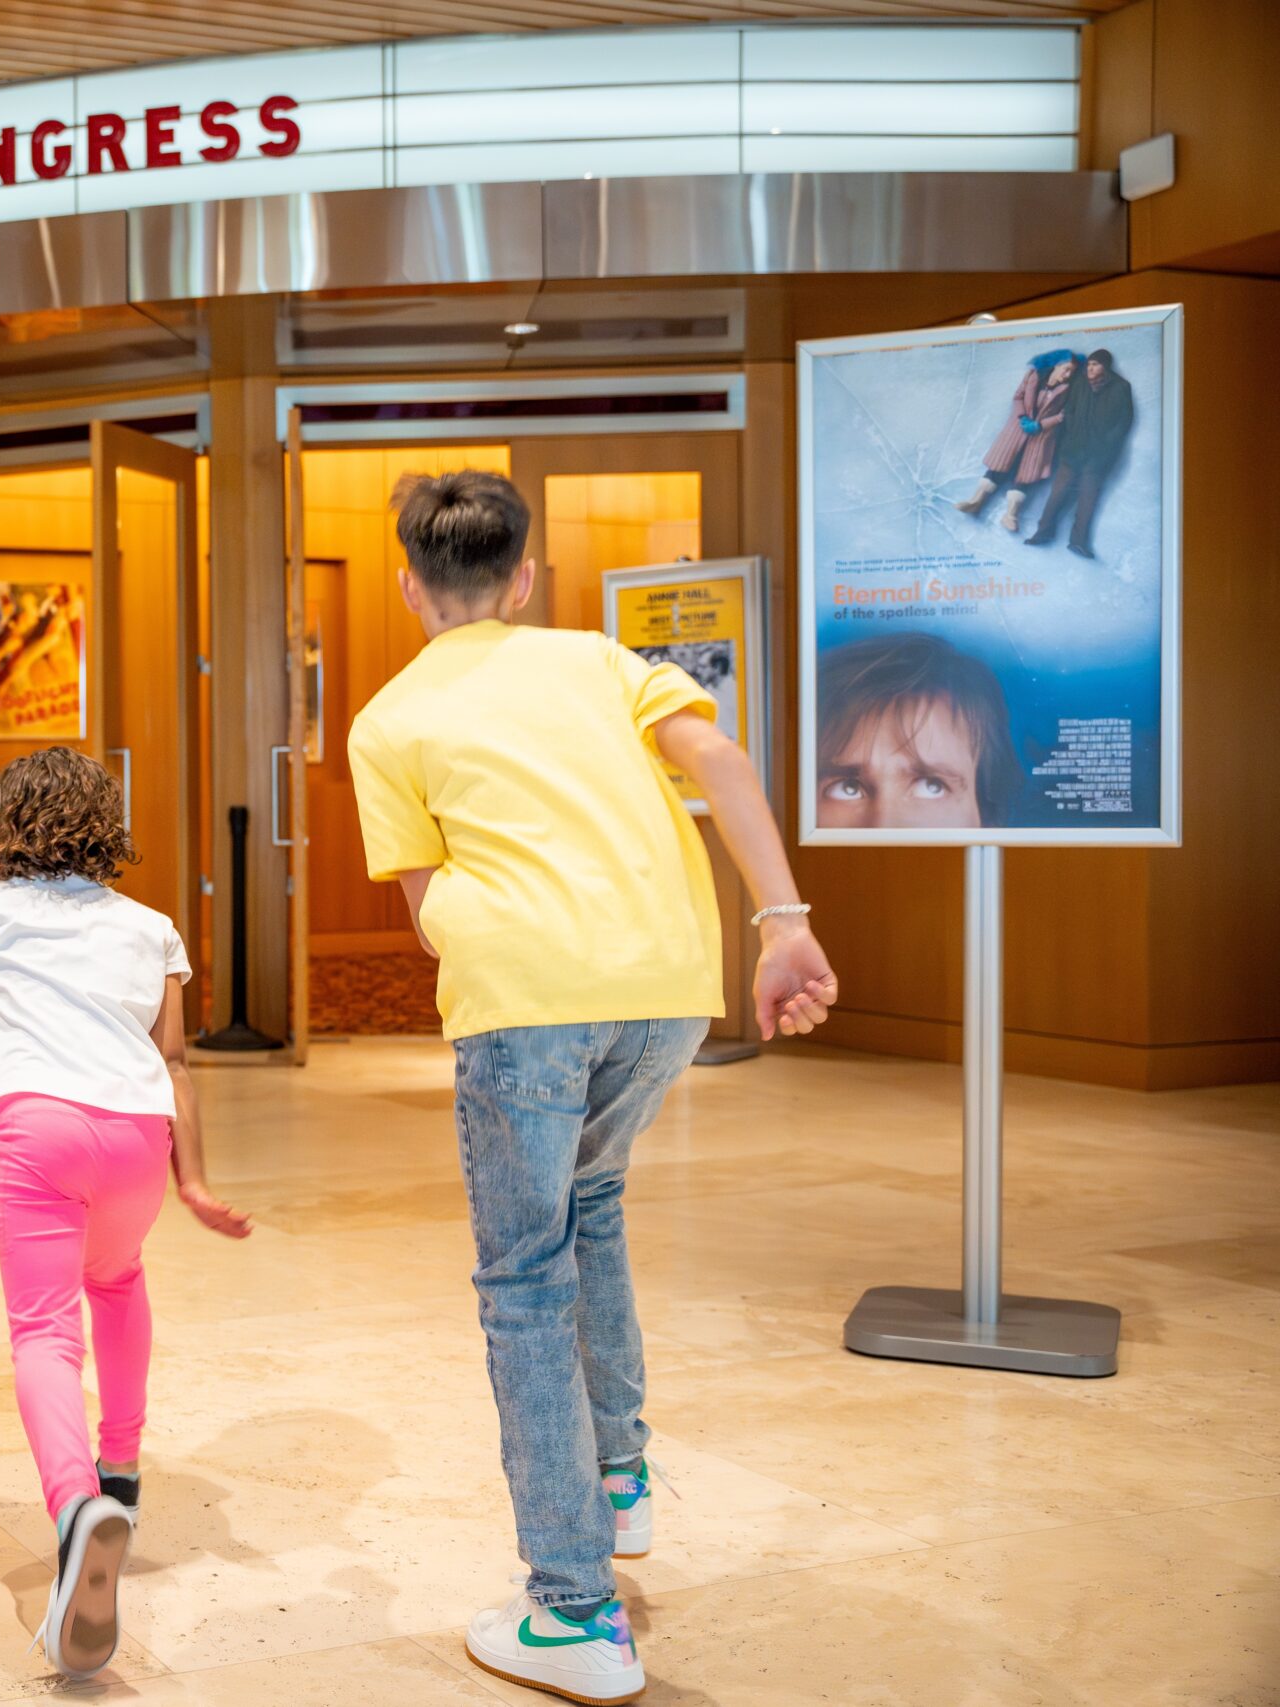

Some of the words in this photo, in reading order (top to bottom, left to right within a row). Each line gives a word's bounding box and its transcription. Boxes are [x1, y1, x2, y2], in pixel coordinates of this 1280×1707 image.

[647, 591, 680, 603] ANNIE
[683, 588, 711, 600] HALL
[833, 580, 920, 605] Eternal
[927, 575, 1046, 602] Sunshine
[834, 606, 848, 620] of
[851, 605, 874, 619] the
[879, 605, 936, 620] spotless
[942, 602, 978, 617] mind
